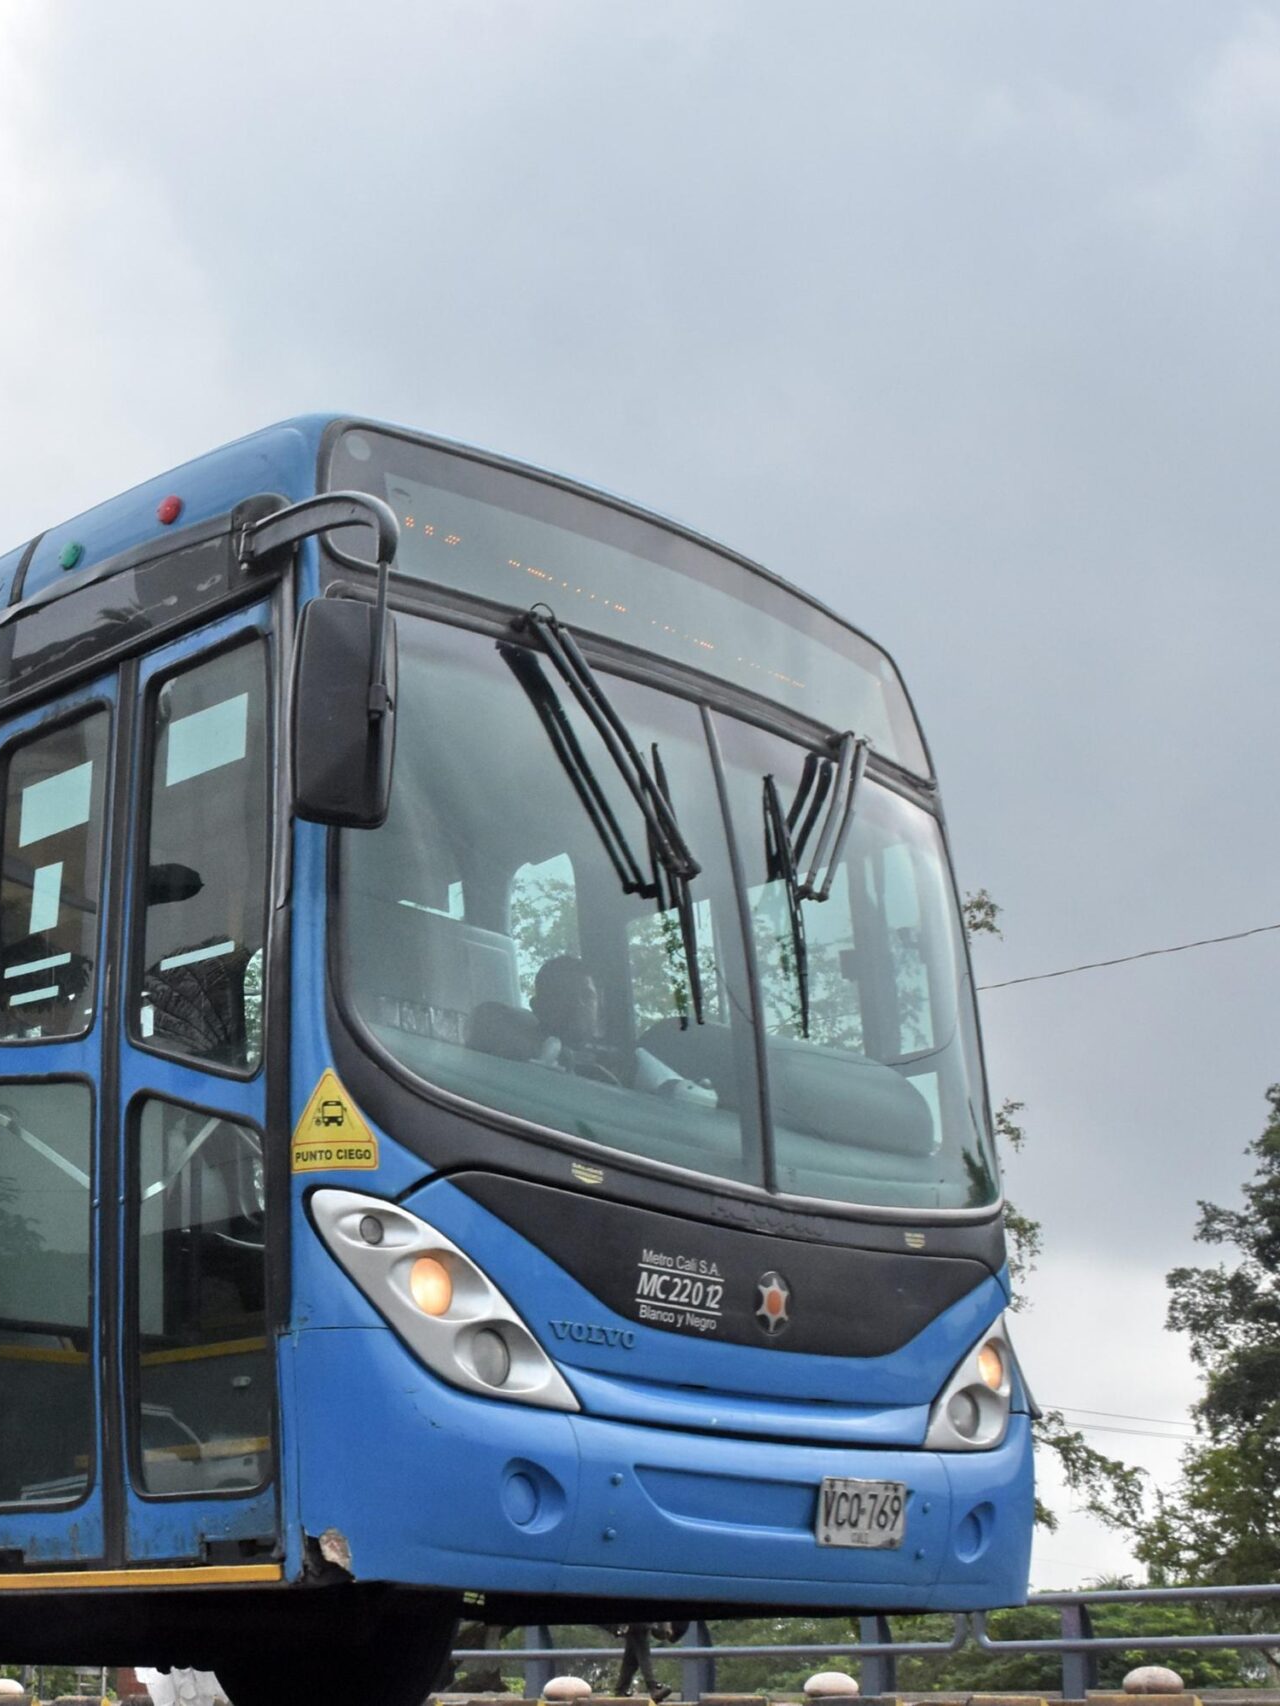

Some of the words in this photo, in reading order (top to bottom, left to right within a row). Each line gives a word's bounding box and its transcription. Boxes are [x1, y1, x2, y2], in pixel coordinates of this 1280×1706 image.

[294, 1149, 333, 1164] PUNTO
[335, 1148, 372, 1161] CIEGO
[642, 1248, 674, 1267] Metro
[676, 1255, 697, 1271] Cali
[636, 1271, 723, 1308] MC22012
[639, 1304, 675, 1323] Blanco
[676, 1314, 685, 1327] y
[685, 1312, 717, 1331] Negro
[548, 1320, 635, 1350] VOLVO
